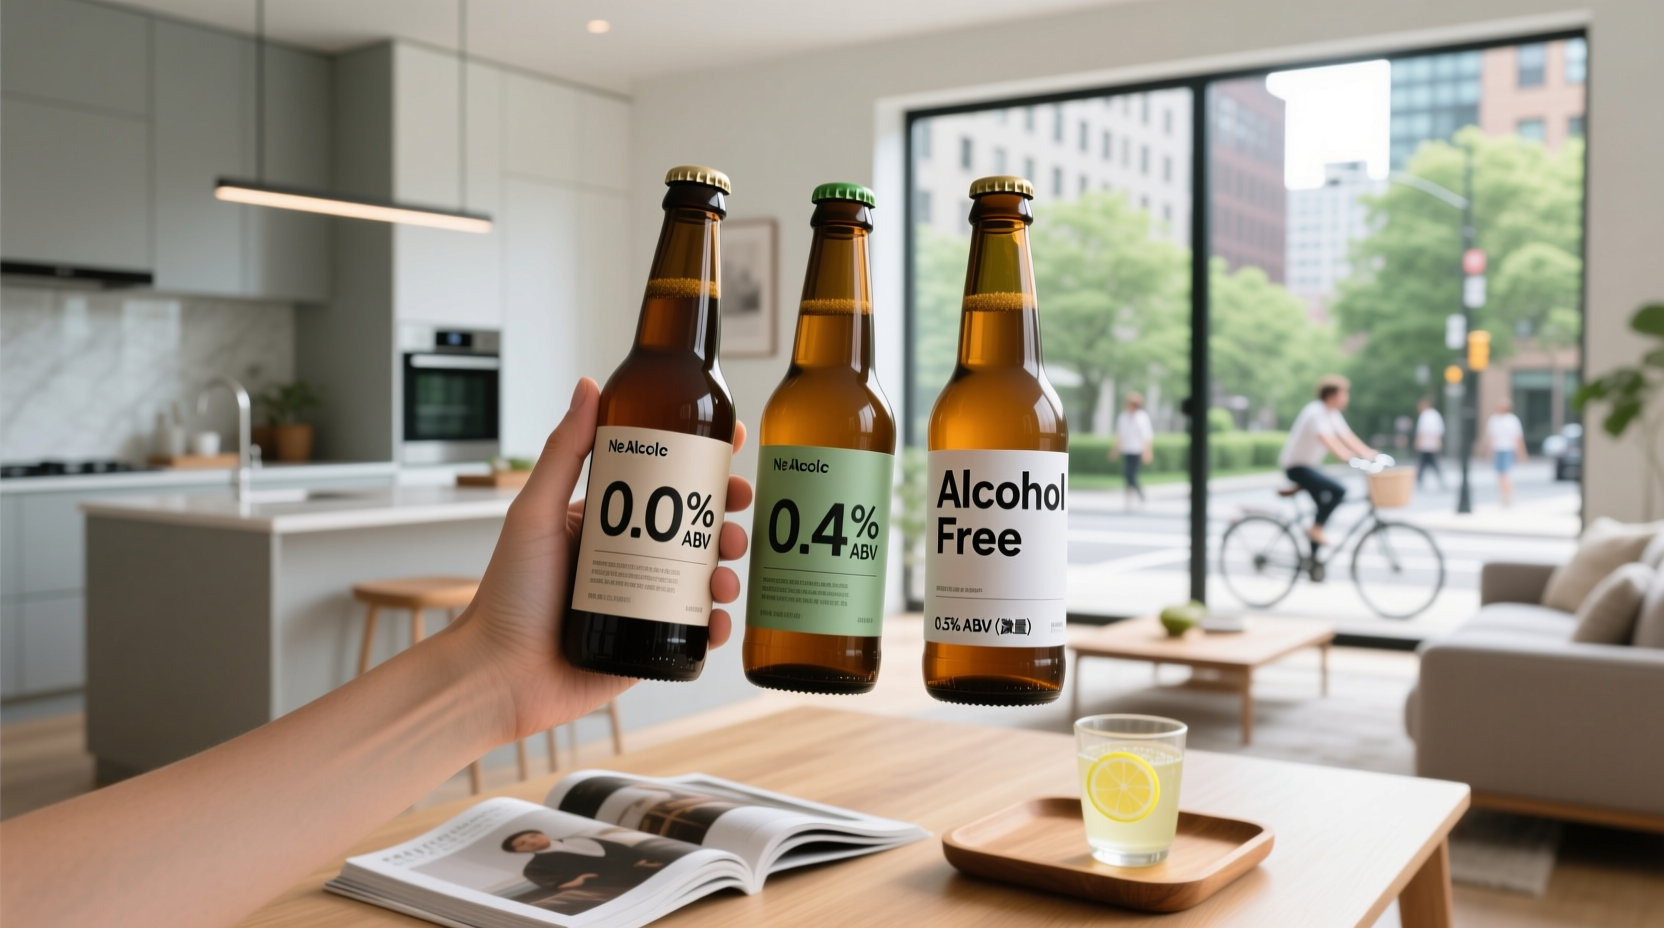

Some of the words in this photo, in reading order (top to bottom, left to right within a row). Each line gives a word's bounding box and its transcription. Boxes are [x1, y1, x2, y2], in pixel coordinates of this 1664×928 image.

[937, 469, 1065, 511] Alcohol
[600, 480, 715, 543] 0.0%
[768, 498, 879, 557] 0.4%
[681, 530, 712, 550] ABV
[849, 543, 879, 561] ABV
[937, 517, 1022, 557] Free
[962, 618, 992, 633] ABV
